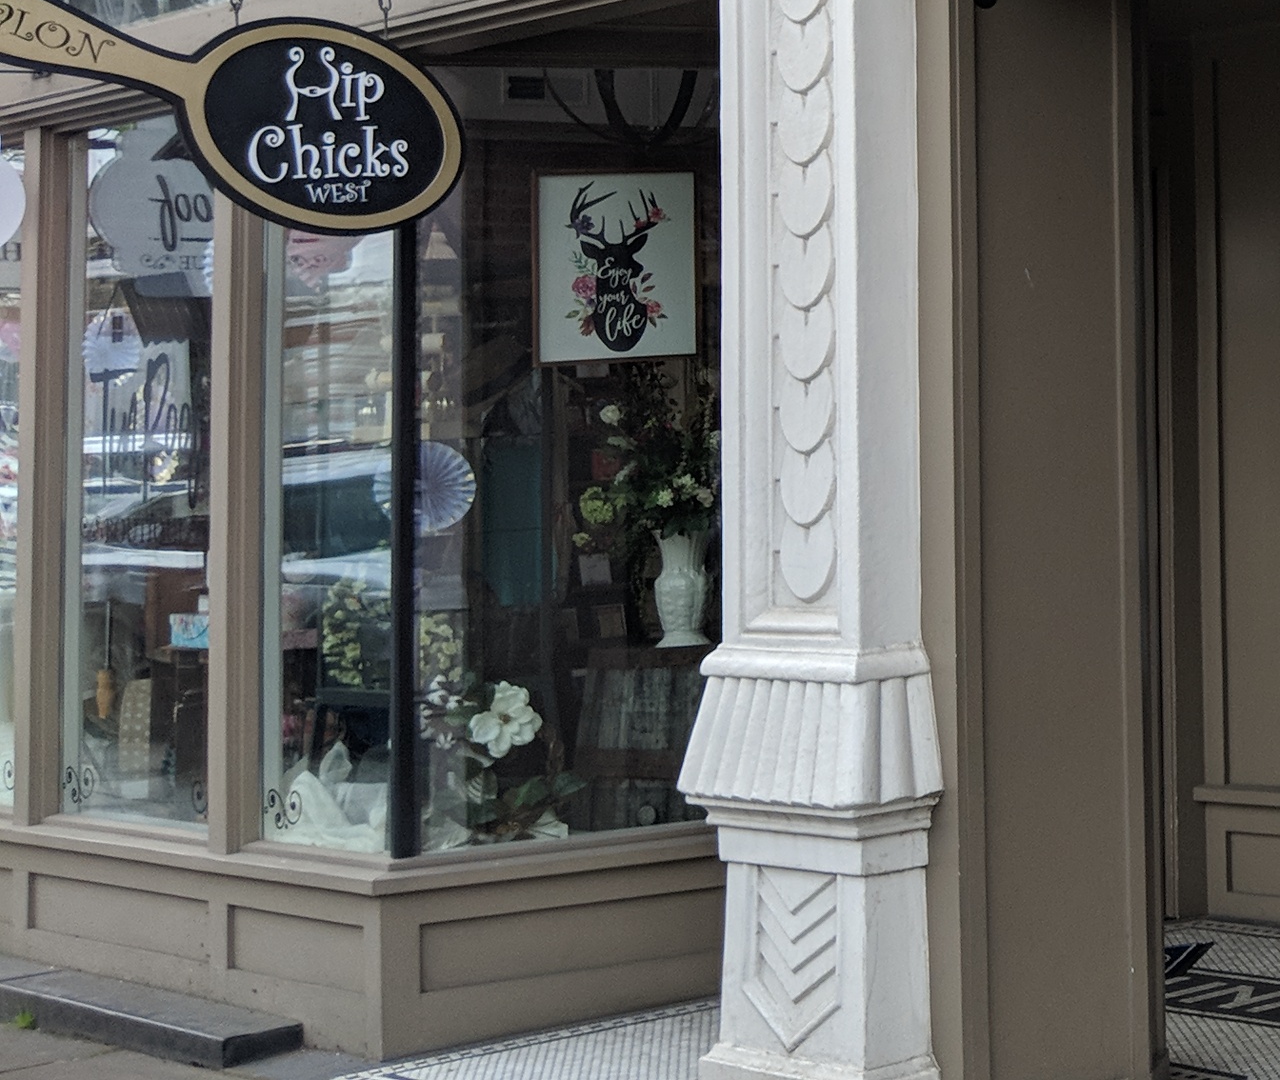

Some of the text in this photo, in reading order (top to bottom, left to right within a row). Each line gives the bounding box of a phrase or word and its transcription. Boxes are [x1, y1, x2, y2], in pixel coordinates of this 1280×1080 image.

[286, 46, 385, 121] Hip
[248, 124, 409, 183] Chicks
[305, 180, 372, 204] WEST
[597, 257, 633, 287] Enjoy
[597, 289, 630, 313] your
[605, 303, 646, 341] life
